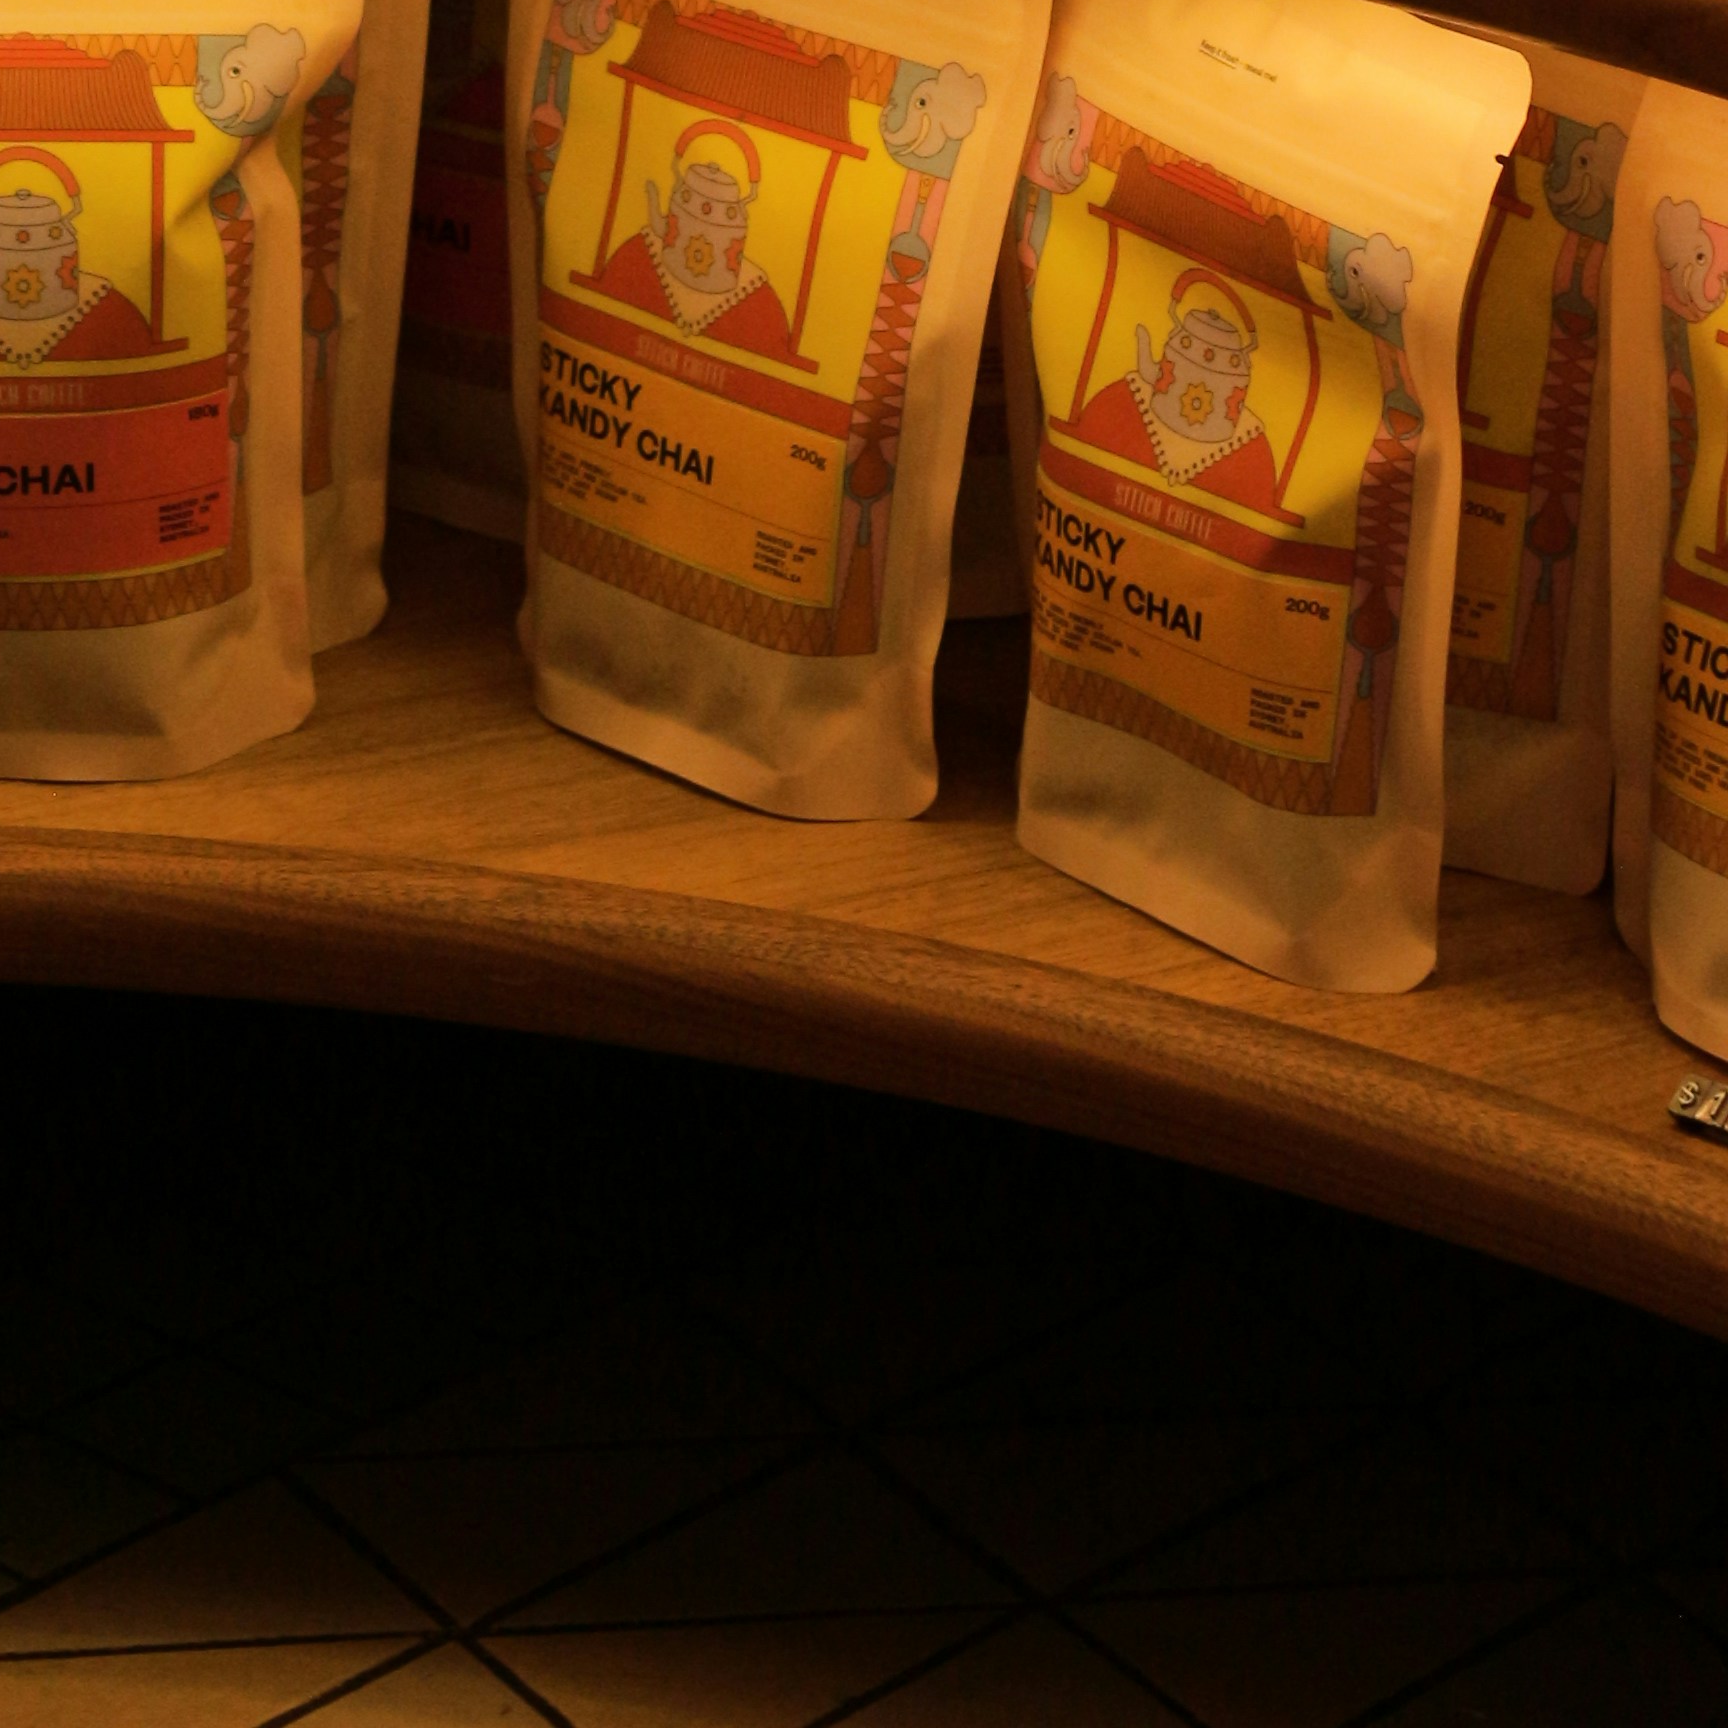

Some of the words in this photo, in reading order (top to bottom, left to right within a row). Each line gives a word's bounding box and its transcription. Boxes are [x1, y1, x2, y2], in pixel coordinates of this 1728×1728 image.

[541, 341, 642, 411] STICKY
[636, 429, 714, 485] CHAI
[790, 444, 826, 471] 200g
[1037, 535, 1116, 601] ANDY
[1123, 584, 1202, 642] CHAI
[1285, 597, 1330, 622] 200g
